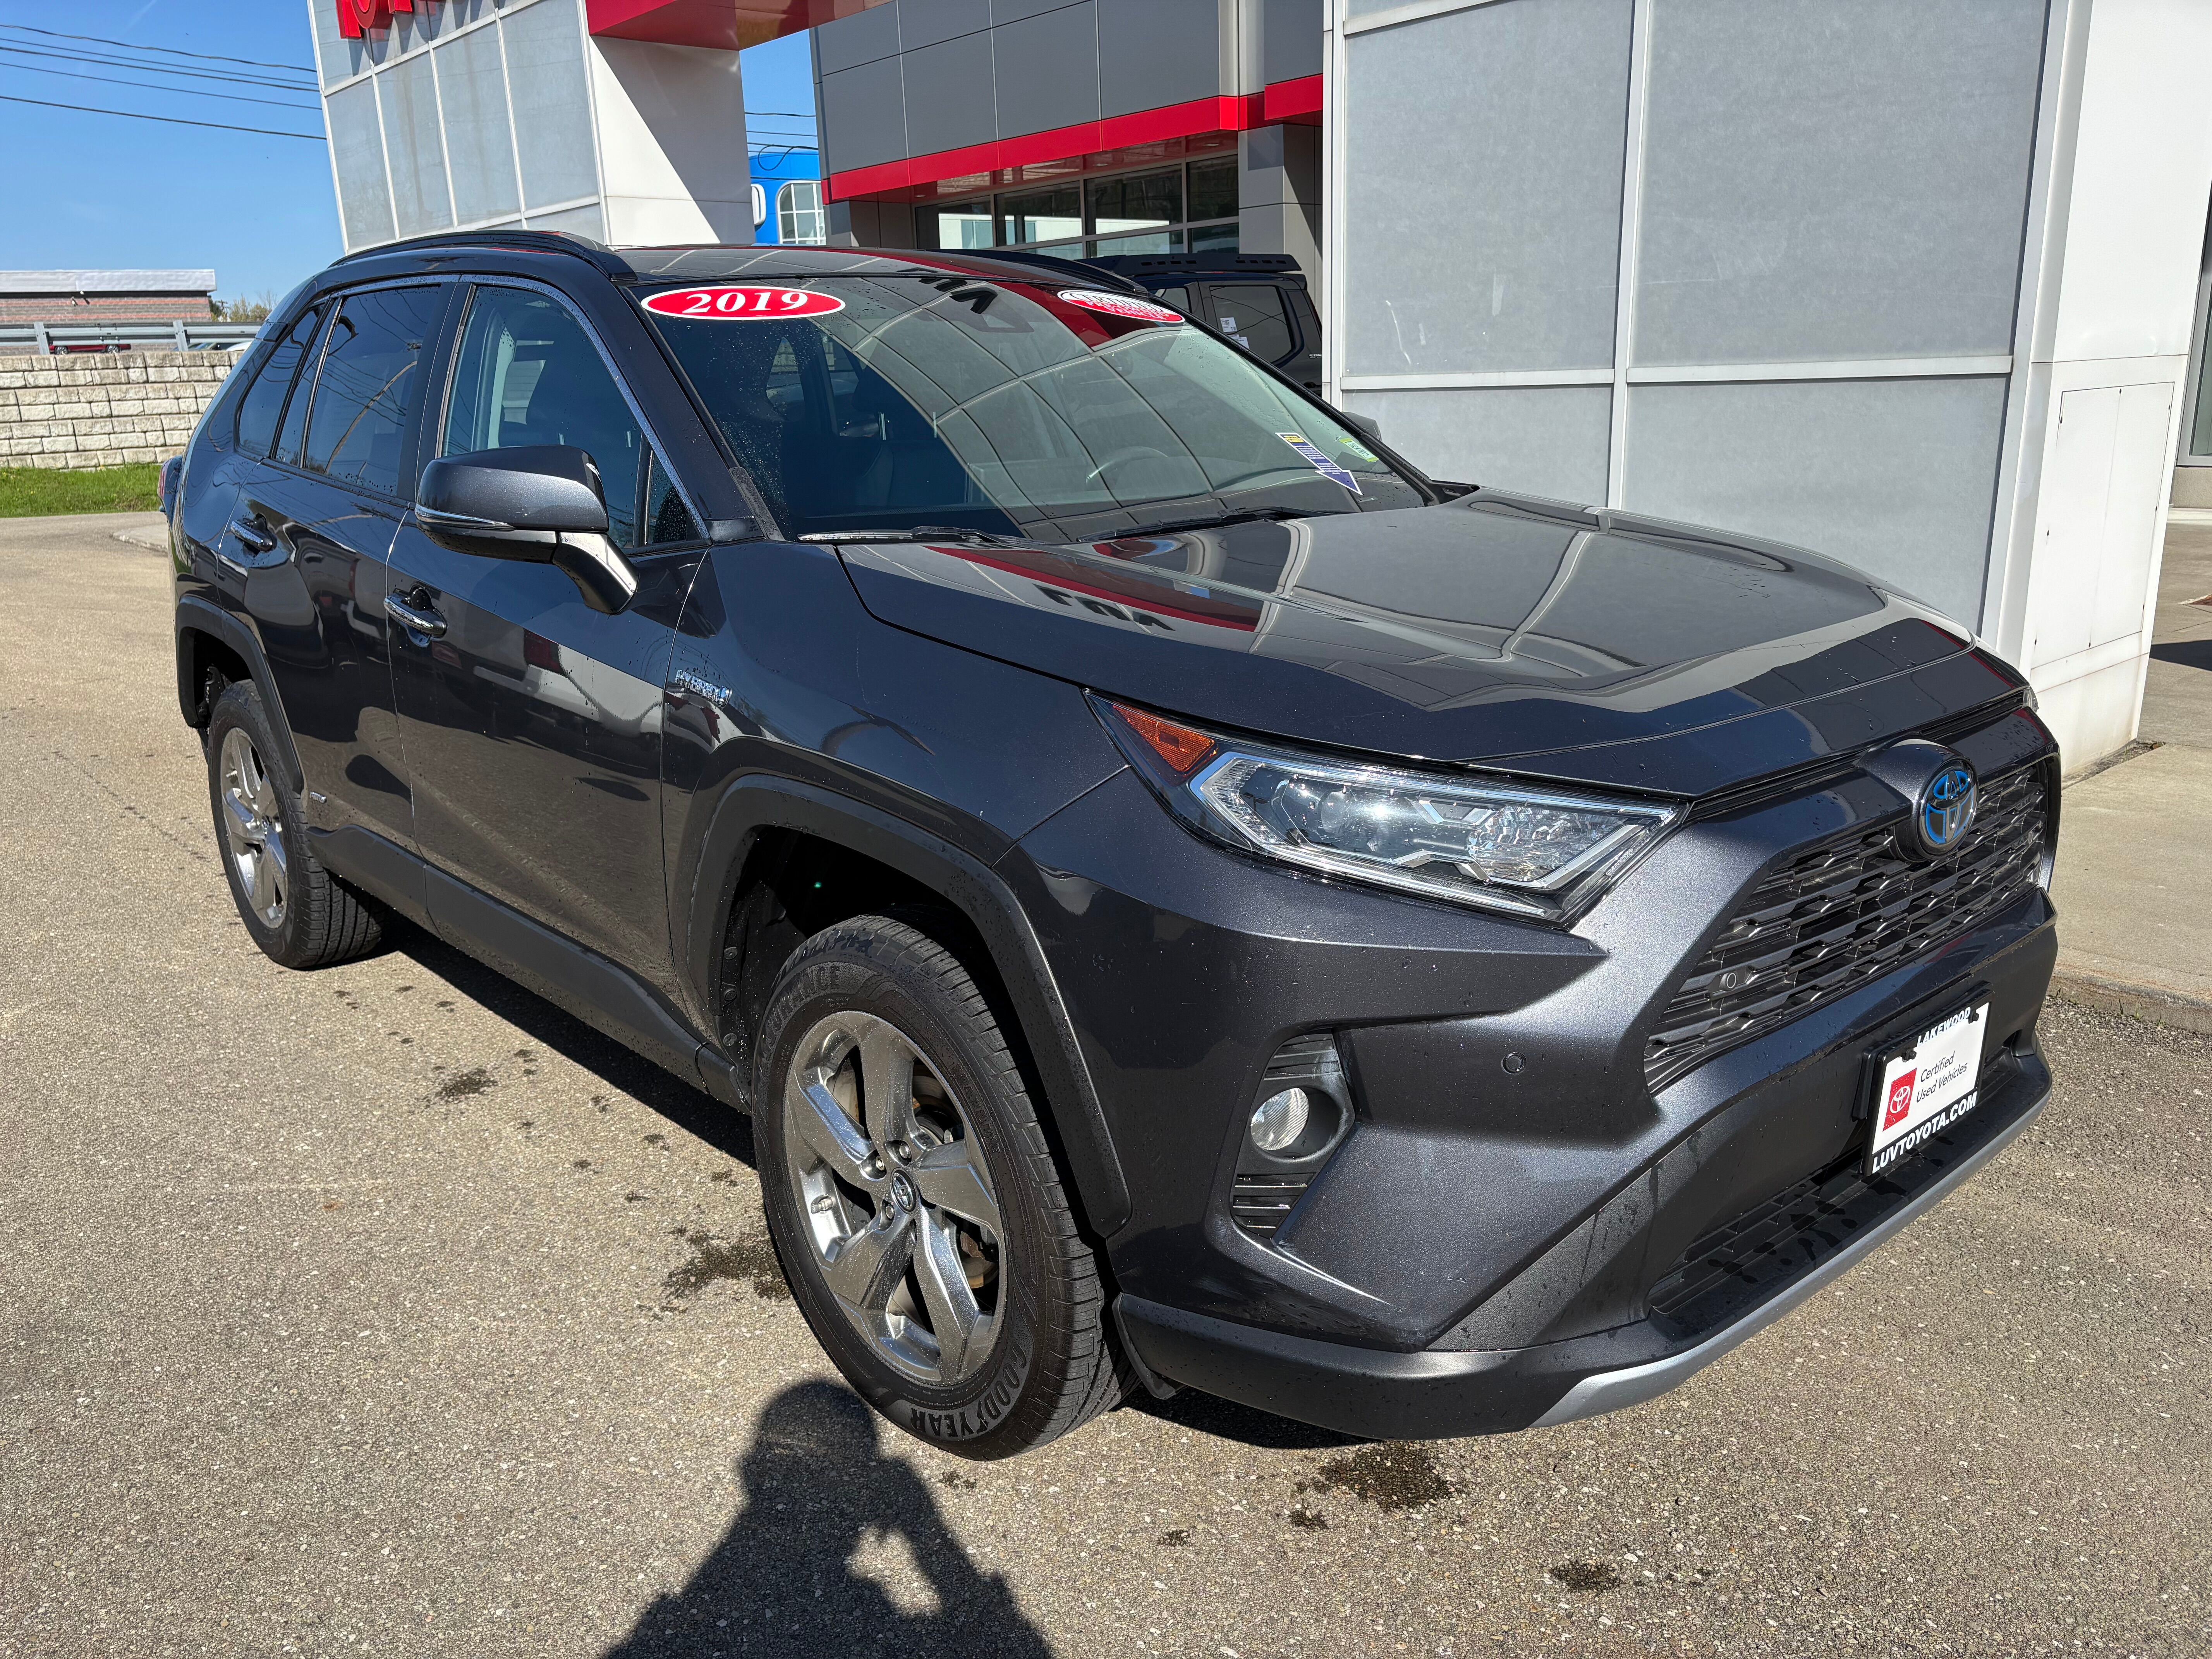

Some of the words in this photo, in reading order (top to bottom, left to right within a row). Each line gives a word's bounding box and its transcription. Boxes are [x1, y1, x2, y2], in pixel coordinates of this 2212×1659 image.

[682, 291, 808, 314] 2019
[1917, 1006, 1971, 1048] LAKEWOOD
[1917, 1081, 1937, 1103] Used
[1938, 1062, 1968, 1090] Vehicles
[1920, 1051, 1955, 1083] Certified
[1872, 1091, 1978, 1174] LUVTOYOTA.COM
